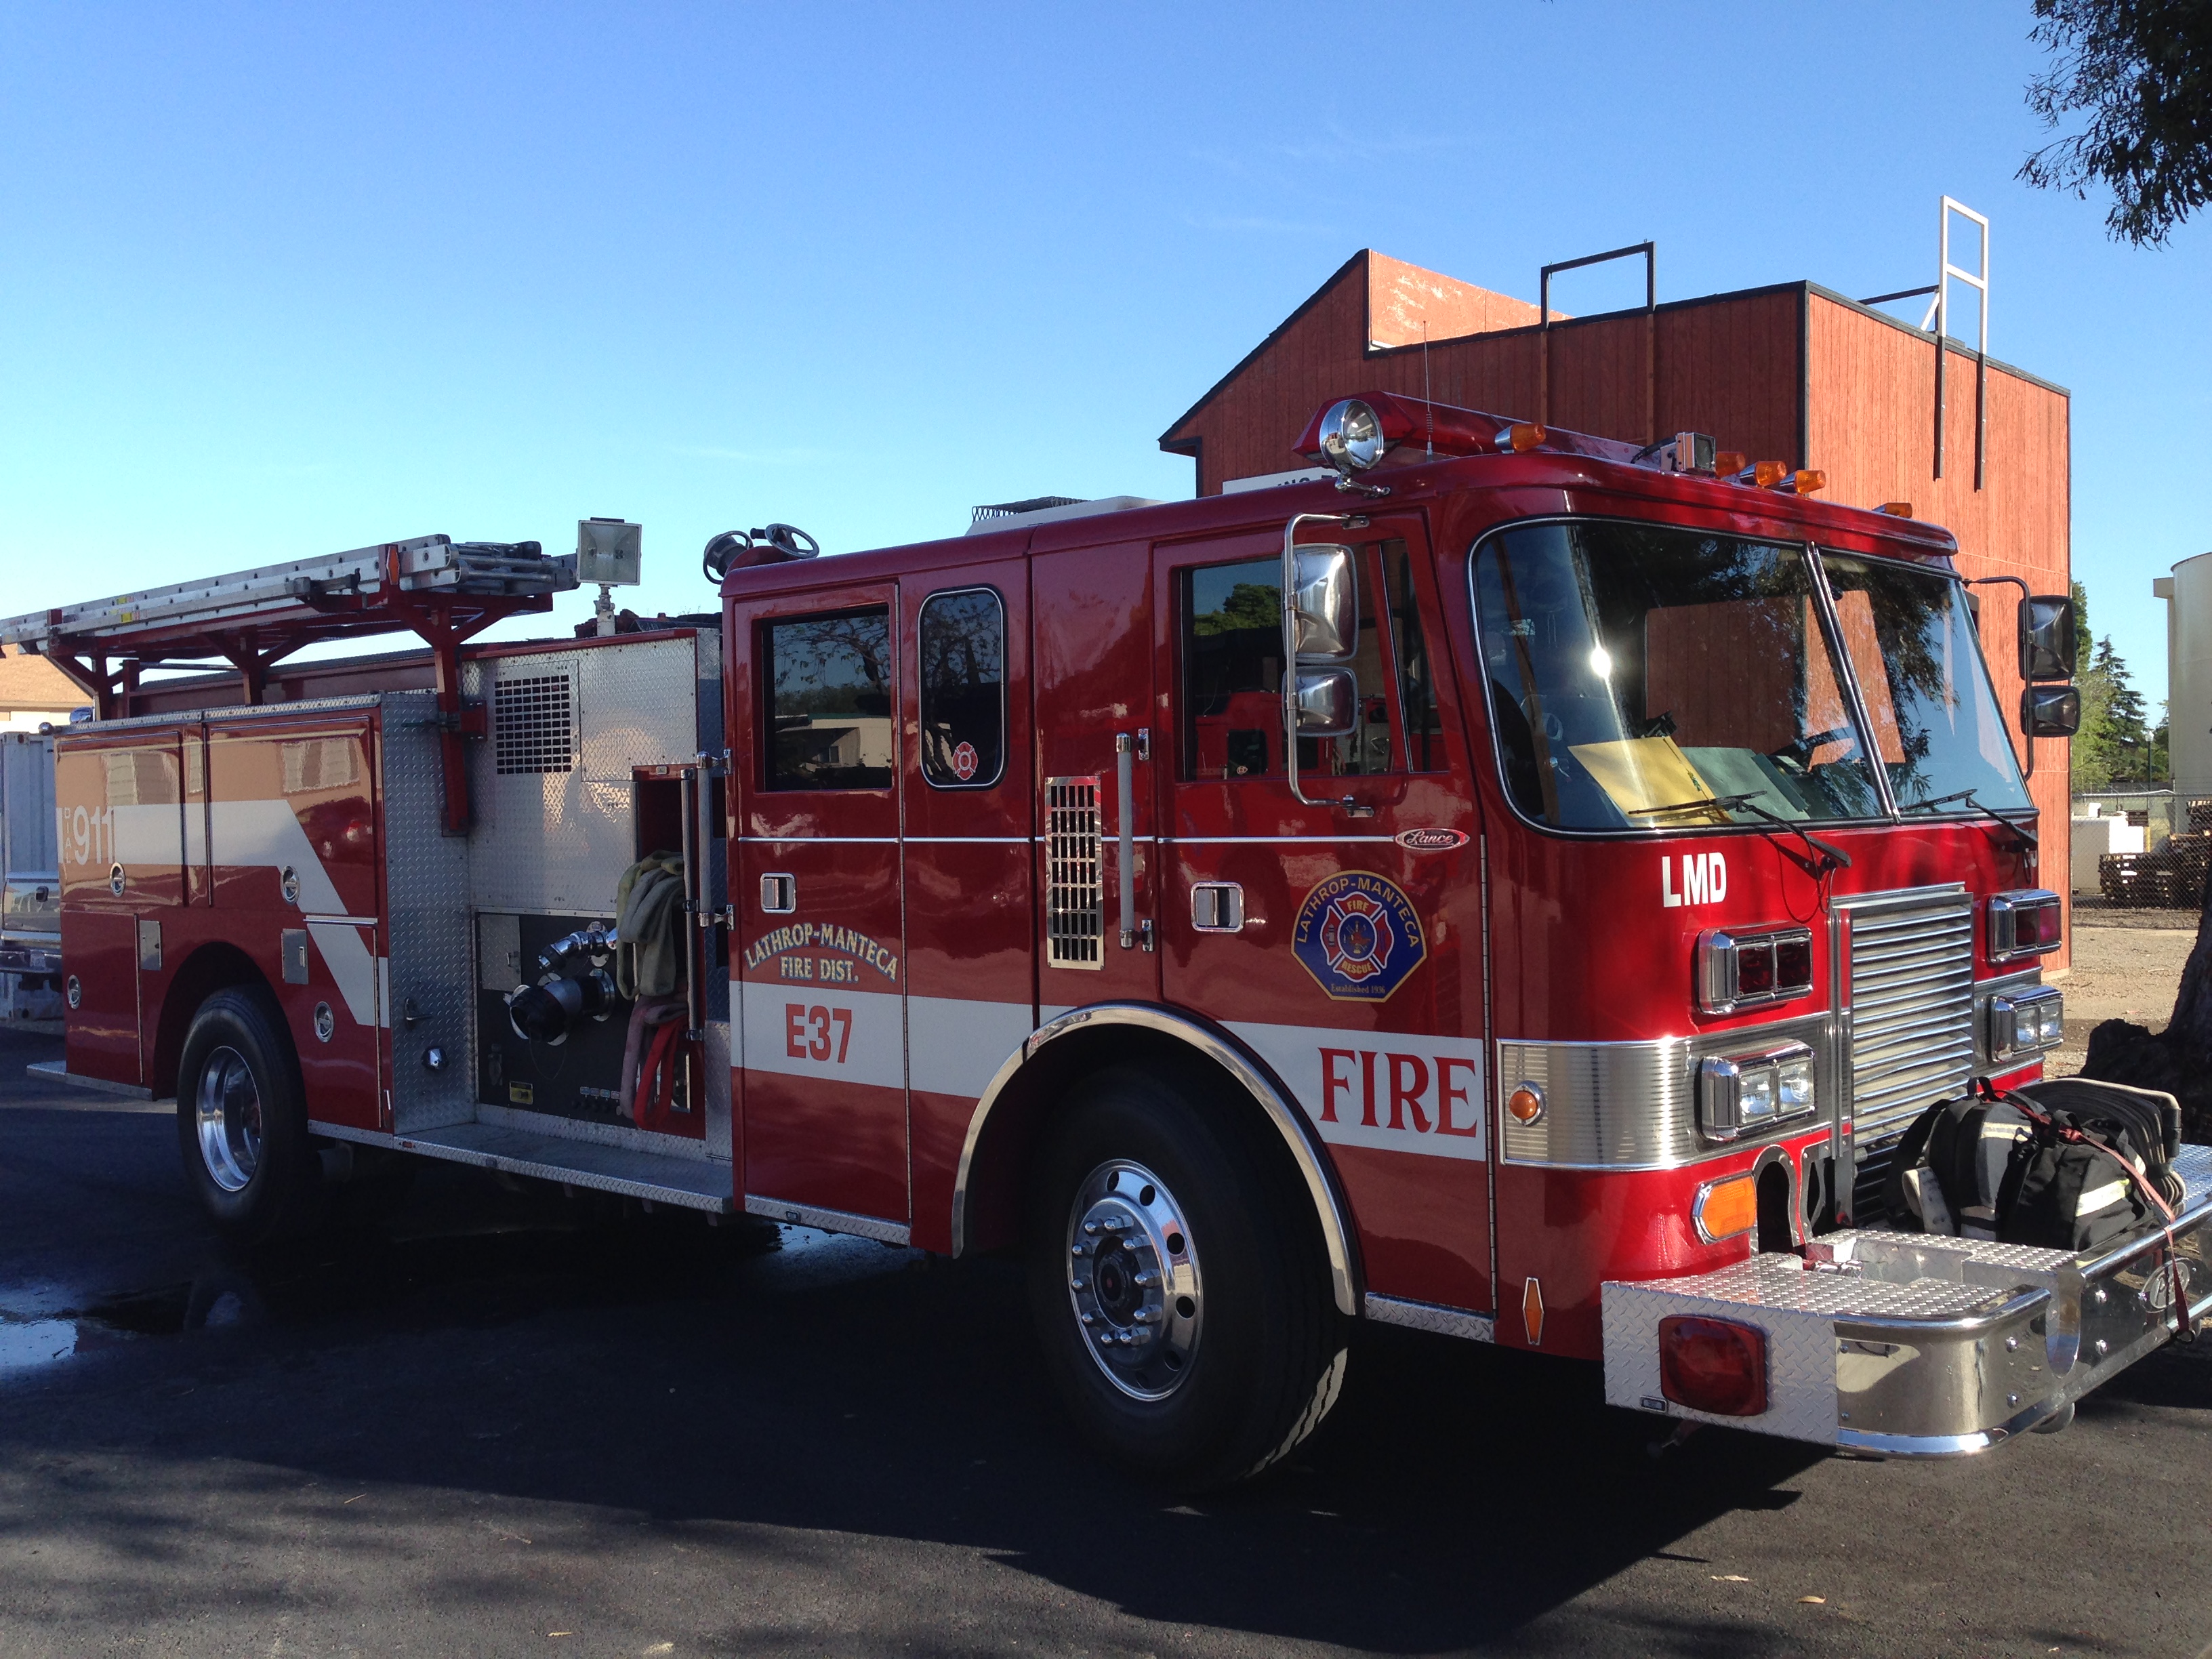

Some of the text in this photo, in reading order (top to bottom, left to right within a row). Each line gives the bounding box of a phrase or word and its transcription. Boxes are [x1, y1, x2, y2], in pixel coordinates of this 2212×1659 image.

[64, 807, 72, 863] DIAL
[73, 805, 113, 865] 911
[1406, 831, 1454, 845] Lance
[1347, 900, 1369, 912] FIRE
[1662, 852, 1727, 907] LMD
[1297, 877, 1420, 947] LATHROP-MANTECA
[744, 922, 898, 982] LATHROP-MANTECA
[780, 956, 859, 983] FIRE DIST.
[1342, 961, 1372, 974] RESCUE
[785, 1003, 853, 1063] E37
[1317, 1047, 1477, 1138] FIRE
